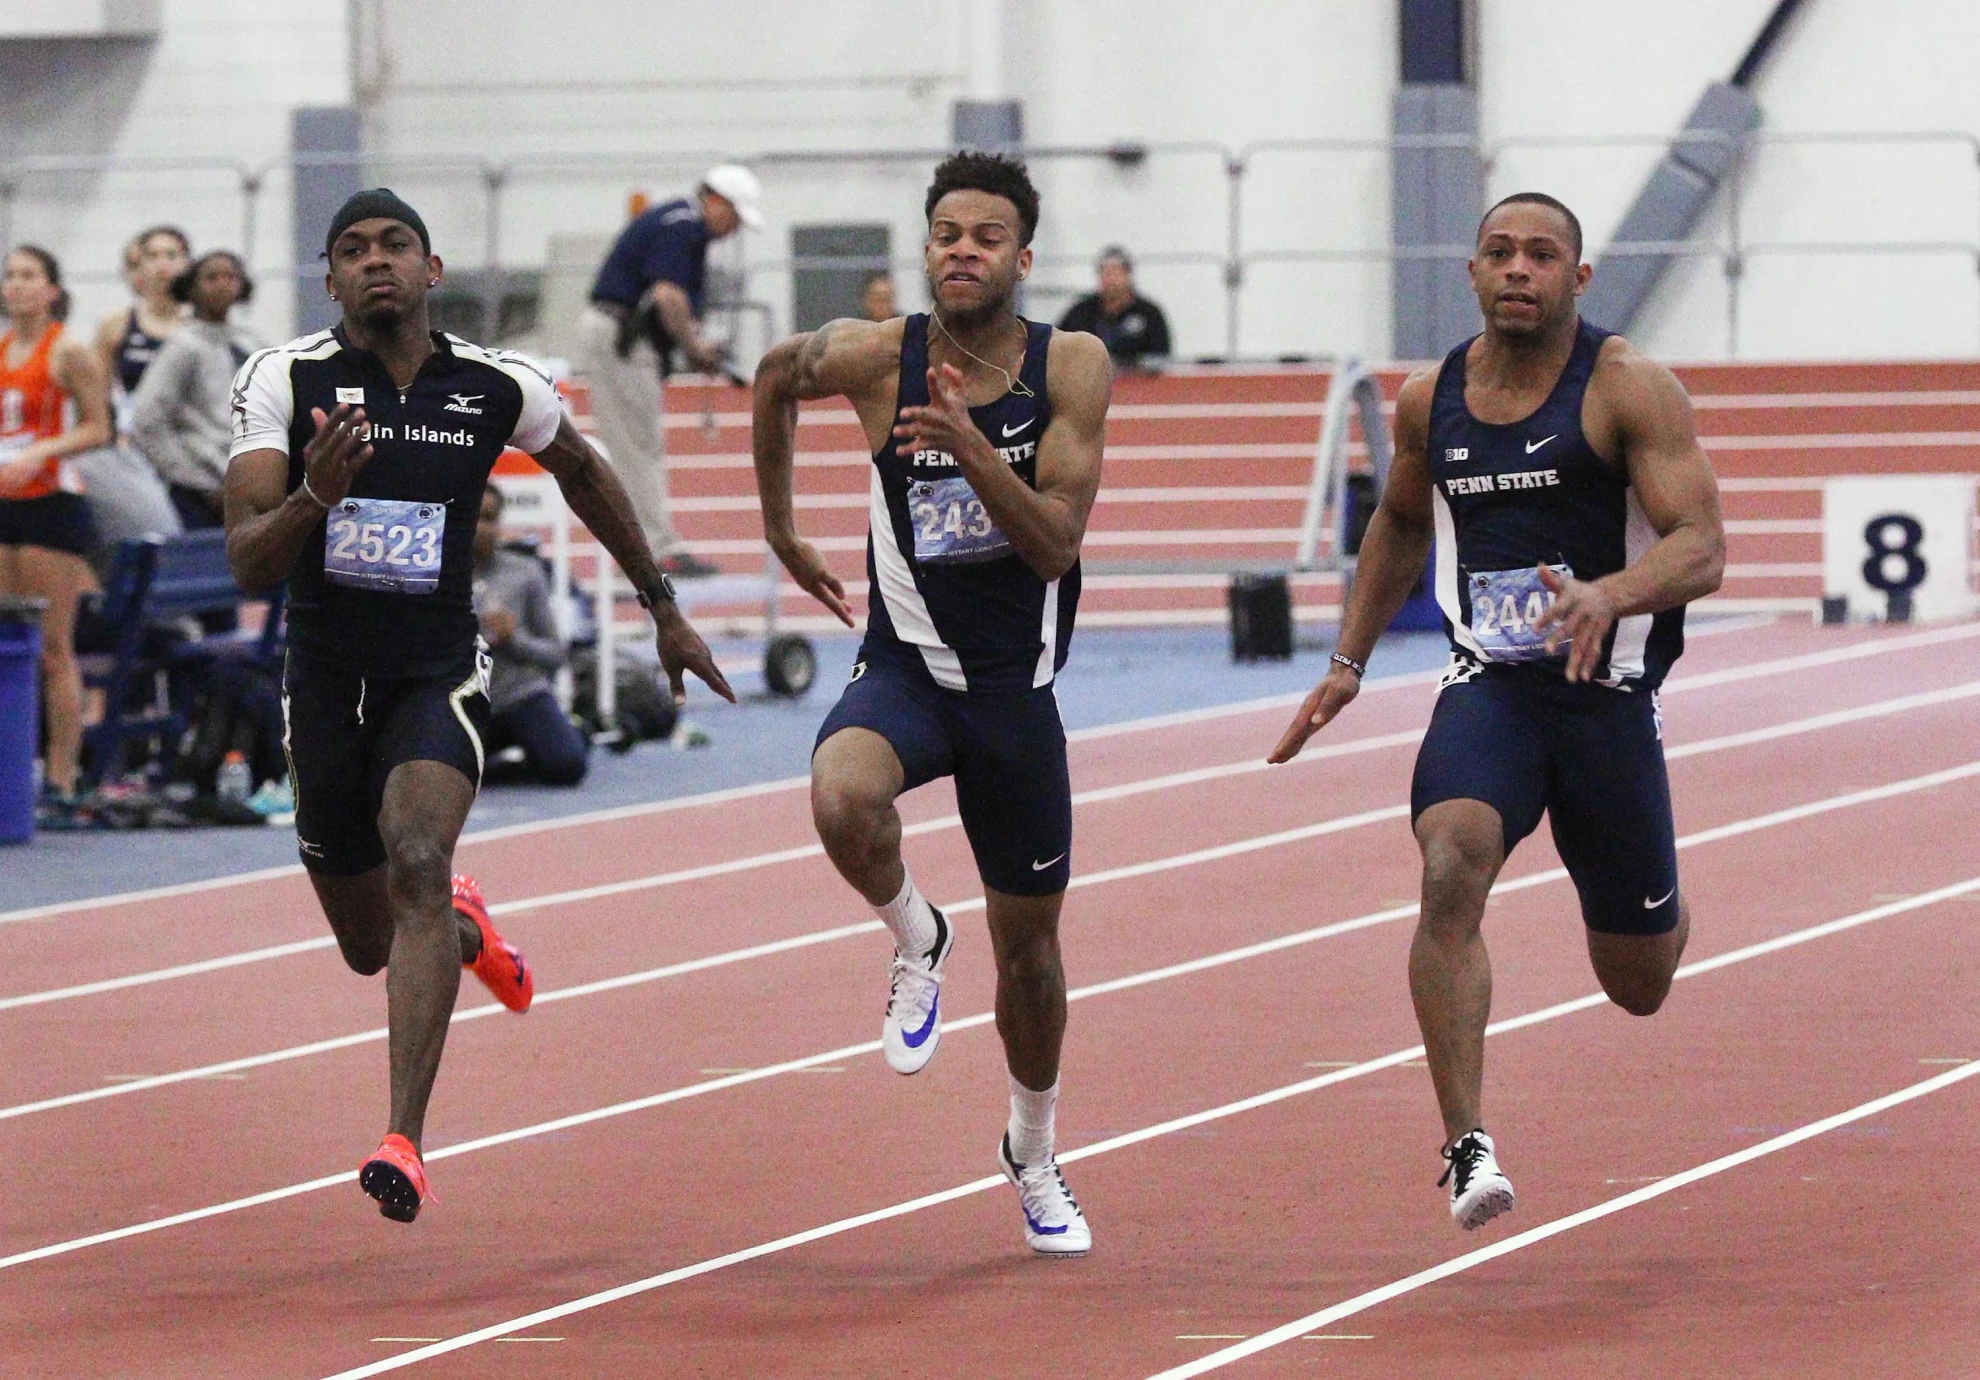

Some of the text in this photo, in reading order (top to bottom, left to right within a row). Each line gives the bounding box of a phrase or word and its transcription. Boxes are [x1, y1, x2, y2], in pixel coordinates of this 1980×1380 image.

[337, 421, 475, 447] rgin Islands
[913, 450, 959, 466] PEN
[1446, 469, 1560, 496] PENN STATE
[332, 519, 438, 567] 2523
[1862, 513, 1927, 592] 8
